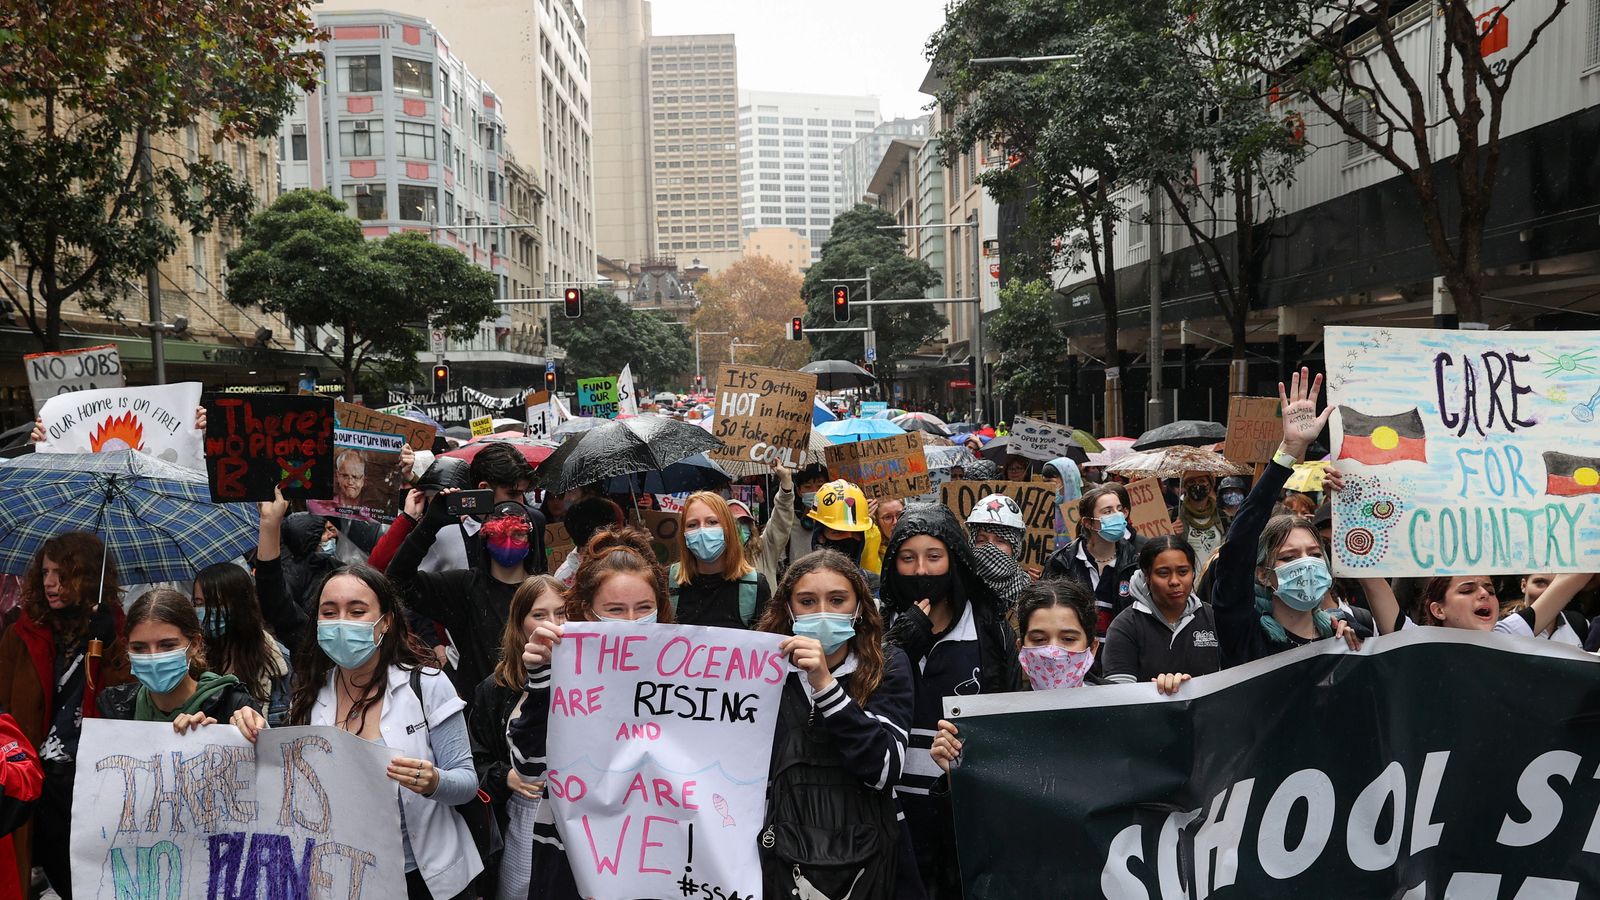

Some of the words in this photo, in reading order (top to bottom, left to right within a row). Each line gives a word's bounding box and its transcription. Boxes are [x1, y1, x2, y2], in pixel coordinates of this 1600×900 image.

[32, 357, 66, 381] NO
[75, 351, 119, 378] JOBS
[583, 381, 612, 393] FUND
[590, 392, 609, 402] OUR
[760, 380, 807, 402] getting
[1433, 351, 1537, 438] CARE
[50, 414, 76, 439] OUR
[119, 397, 128, 408] IS
[152, 407, 181, 436] FIRE!
[581, 402, 618, 415] FUTURE
[720, 391, 760, 417] HOT
[760, 403, 772, 417] in
[1289, 414, 1314, 423] ACTION
[472, 418, 490, 428] CHANGE
[741, 420, 768, 441] take
[772, 428, 797, 447] off
[794, 432, 810, 449] all
[409, 428, 427, 449] IS
[849, 437, 898, 460] CLIMATE
[906, 434, 918, 449] IS
[1021, 435, 1038, 443] OPEN
[750, 442, 807, 468] COAL!
[217, 456, 248, 496] B
[1456, 444, 1537, 498] FOR
[1408, 502, 1586, 569] COUNTRY
[560, 632, 647, 675] THE
[656, 636, 786, 685] OCEANS
[552, 686, 605, 717] ARE
[634, 681, 760, 723] RISING
[615, 721, 661, 741] AND
[95, 744, 259, 833] THERE
[276, 735, 333, 833] IS
[547, 769, 587, 802] SO
[622, 772, 700, 809] ARE
[1101, 750, 1451, 900] SCHOOL
[110, 840, 182, 900] NO
[207, 832, 377, 900] PLANET
